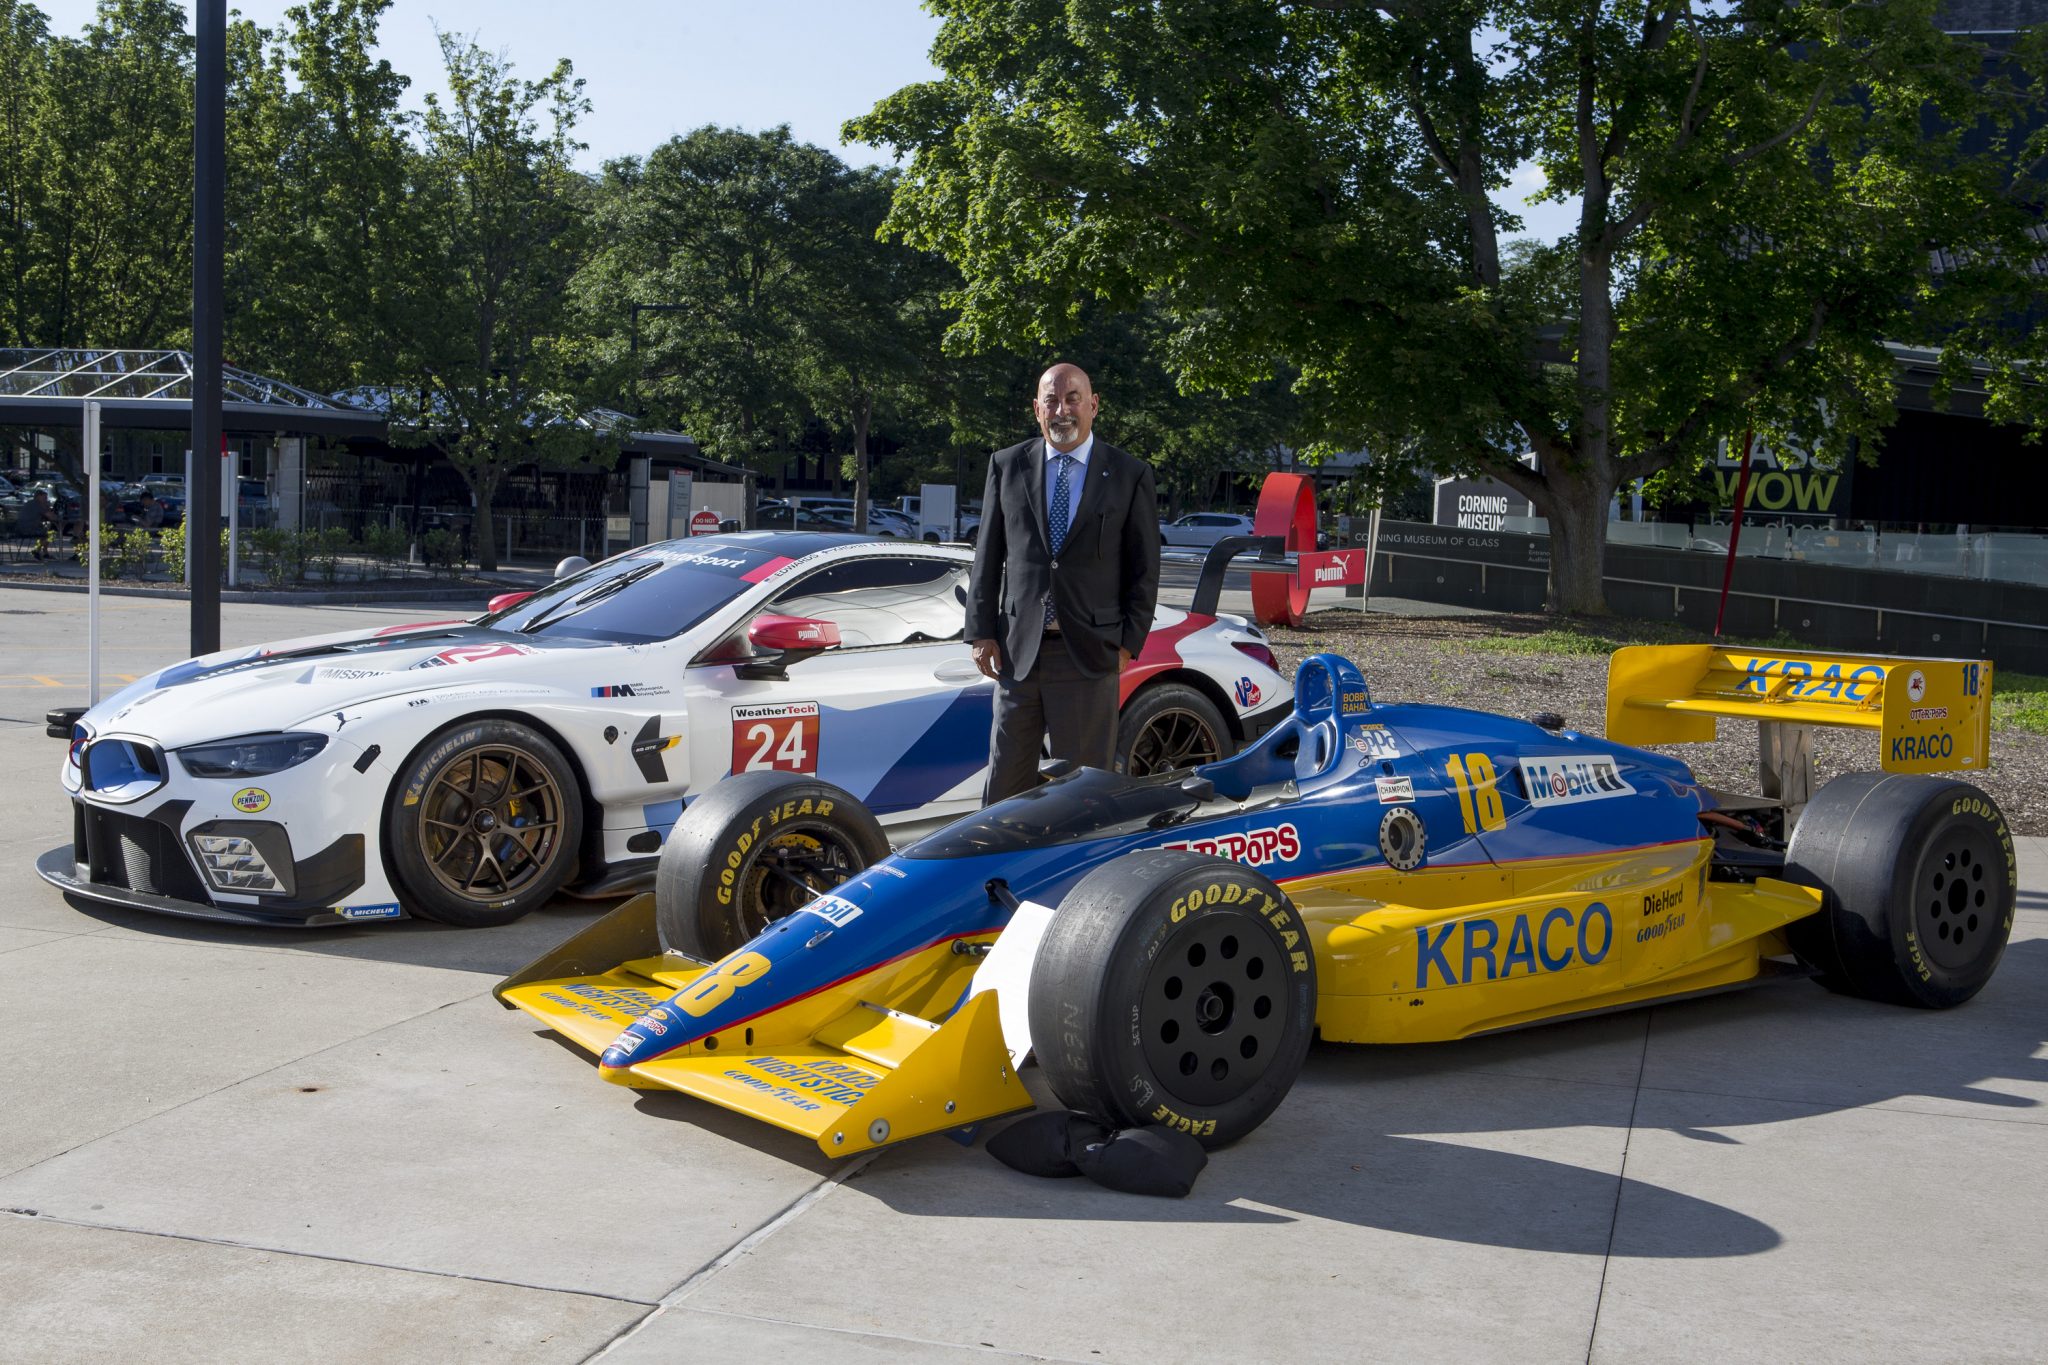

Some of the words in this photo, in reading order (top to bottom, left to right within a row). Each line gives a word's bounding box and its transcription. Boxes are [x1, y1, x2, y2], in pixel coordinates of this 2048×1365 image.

[1458, 495, 1508, 513] CORNING
[1714, 471, 1839, 511] WOW
[1457, 513, 1506, 532] MUSEUM
[1355, 532, 1401, 543] CONING
[1404, 535, 1447, 545] MUSEUM
[1450, 537, 1464, 545] OF
[1467, 538, 1500, 548] GLASS
[774, 553, 820, 578] EDWARDS
[1315, 566, 1343, 582] PUMA
[798, 630, 819, 642] PUMA
[611, 684, 636, 697] M
[1234, 676, 1253, 708] VP
[1735, 658, 1885, 702] KRAC
[1962, 663, 1979, 697] 18
[408, 698, 428, 708] FIA
[736, 704, 816, 718] WeatherTech
[1342, 703, 1368, 713] RAHAL
[1343, 692, 1368, 703] BOBBY
[1931, 708, 1948, 718] POPS
[418, 731, 476, 781] MICHELIN
[744, 720, 807, 773] 24
[1892, 733, 1953, 762] KRACO
[1380, 785, 1411, 795] CHAMPION
[1445, 752, 1507, 835] 18
[1526, 763, 1598, 799] Mobil
[237, 794, 266, 807] PENNZOIL
[1218, 826, 1299, 864] POPS
[354, 907, 395, 916] MICHELIN
[1643, 883, 1684, 916] DieHard
[1416, 901, 1613, 989] KRACO
[1906, 931, 1932, 982] EAGLE
[668, 948, 772, 1017] 8
[560, 983, 656, 1017] NIGHTSTIC
[1131, 1004, 1141, 1047] SETUP
[801, 1060, 881, 1090] KRACO
[1152, 1104, 1218, 1137] EAGLE
